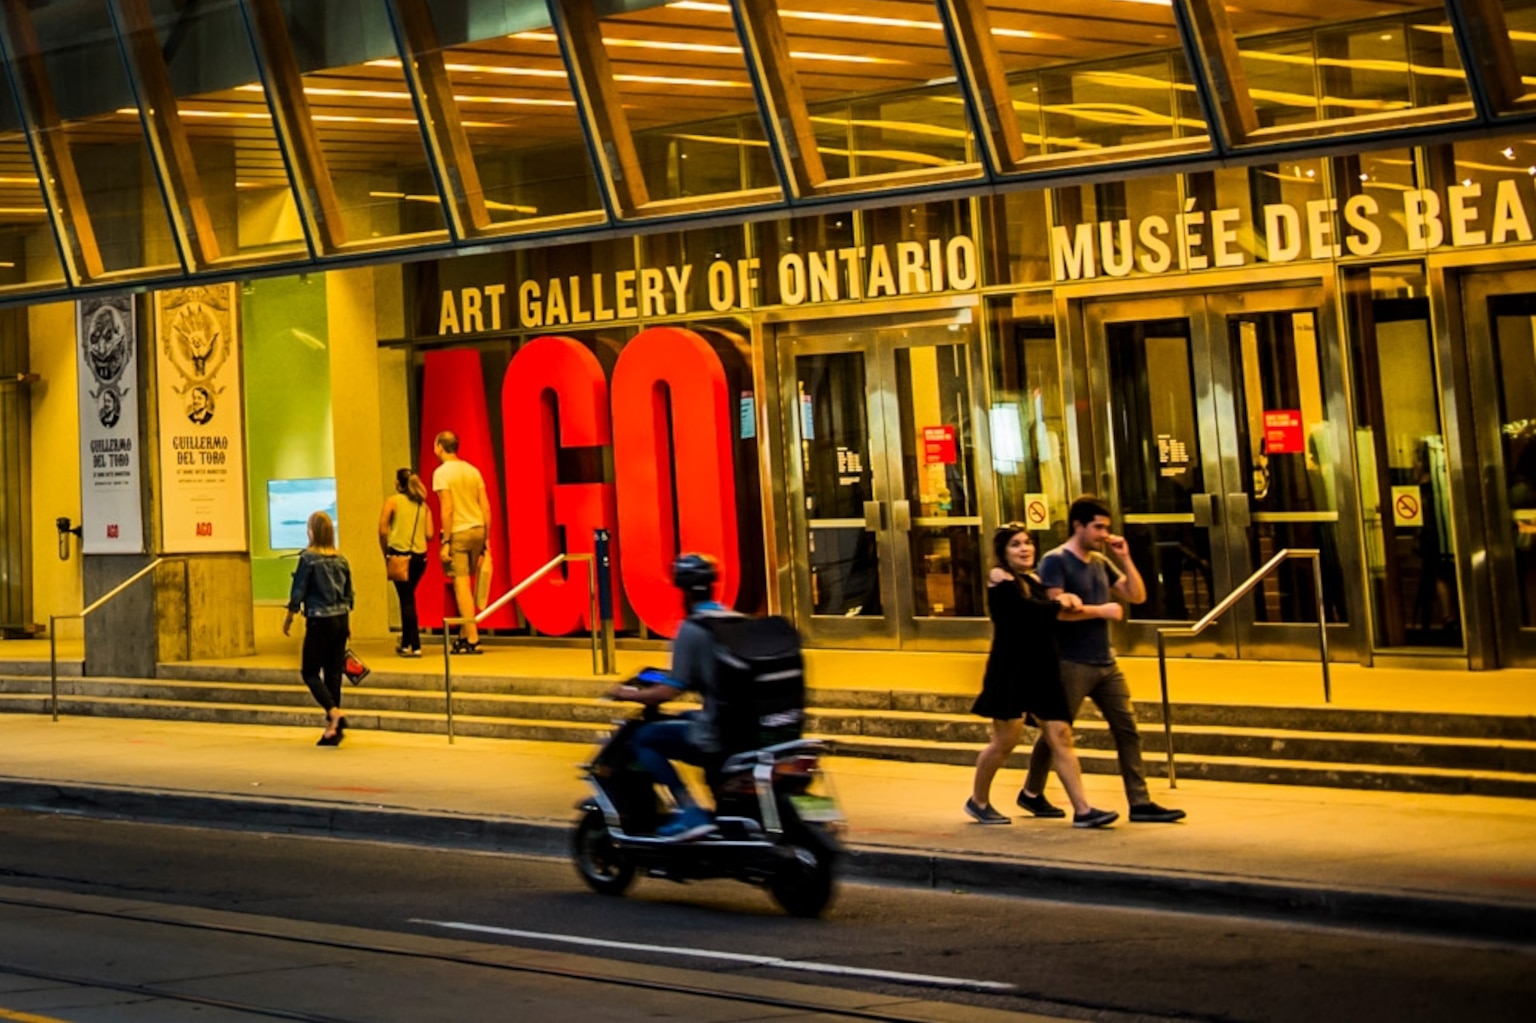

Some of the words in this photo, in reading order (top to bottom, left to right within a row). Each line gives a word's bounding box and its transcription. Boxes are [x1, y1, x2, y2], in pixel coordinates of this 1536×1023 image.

[1052, 198, 1245, 281] MUSÉE
[1264, 194, 1382, 263] DES
[1403, 178, 1536, 251] BEA
[438, 284, 505, 335] ART
[519, 264, 693, 328] GALLERY
[708, 257, 761, 312] OF
[779, 234, 977, 306] ONTARIO
[90, 438, 132, 453] GUILLERMO
[173, 436, 228, 450] GUILLERMO
[93, 454, 106, 468] DEL
[109, 453, 130, 468] TORO
[177, 451, 195, 465] DEL
[200, 451, 226, 465] TORO
[415, 326, 741, 639] AGO
[196, 522, 213, 537] AGO
